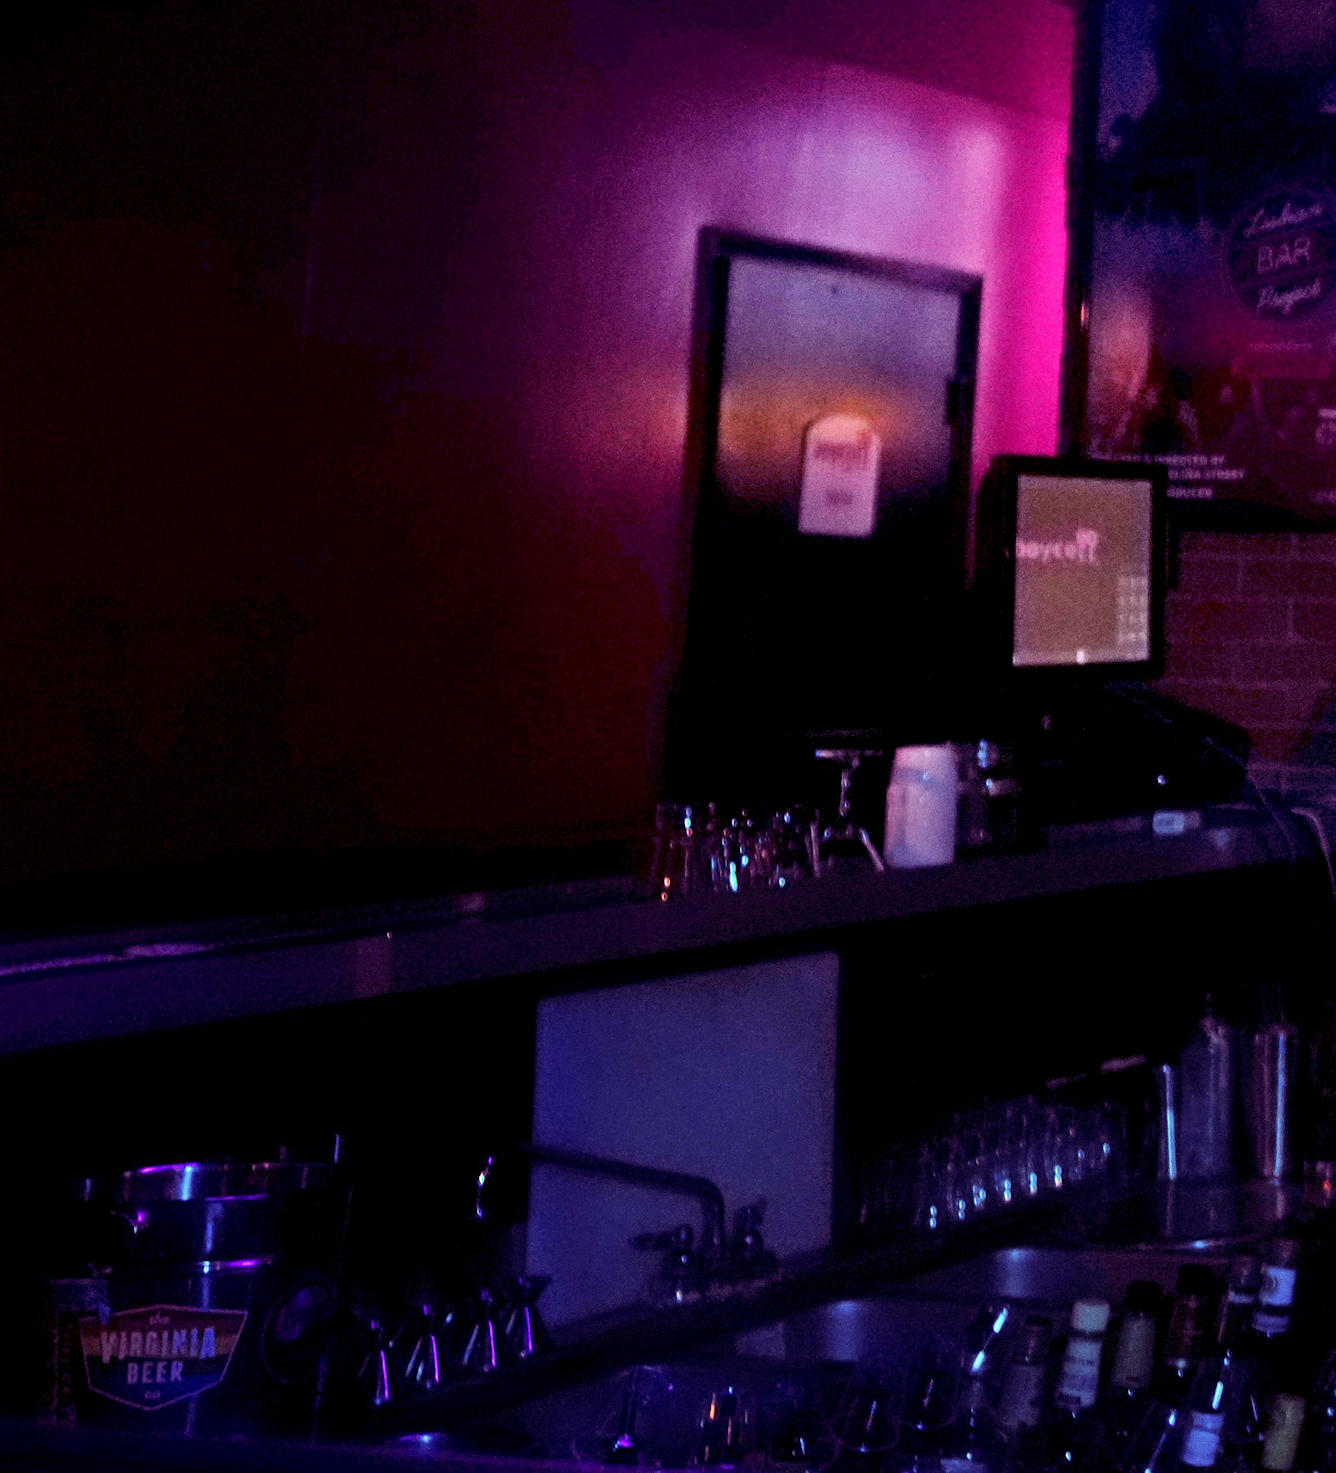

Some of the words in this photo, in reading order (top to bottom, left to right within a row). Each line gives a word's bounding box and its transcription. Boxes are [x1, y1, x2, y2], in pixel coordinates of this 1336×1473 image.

[1257, 236, 1312, 275] BAR
[101, 1326, 217, 1365] VIRGINIA
[126, 1360, 184, 1385] BEER
